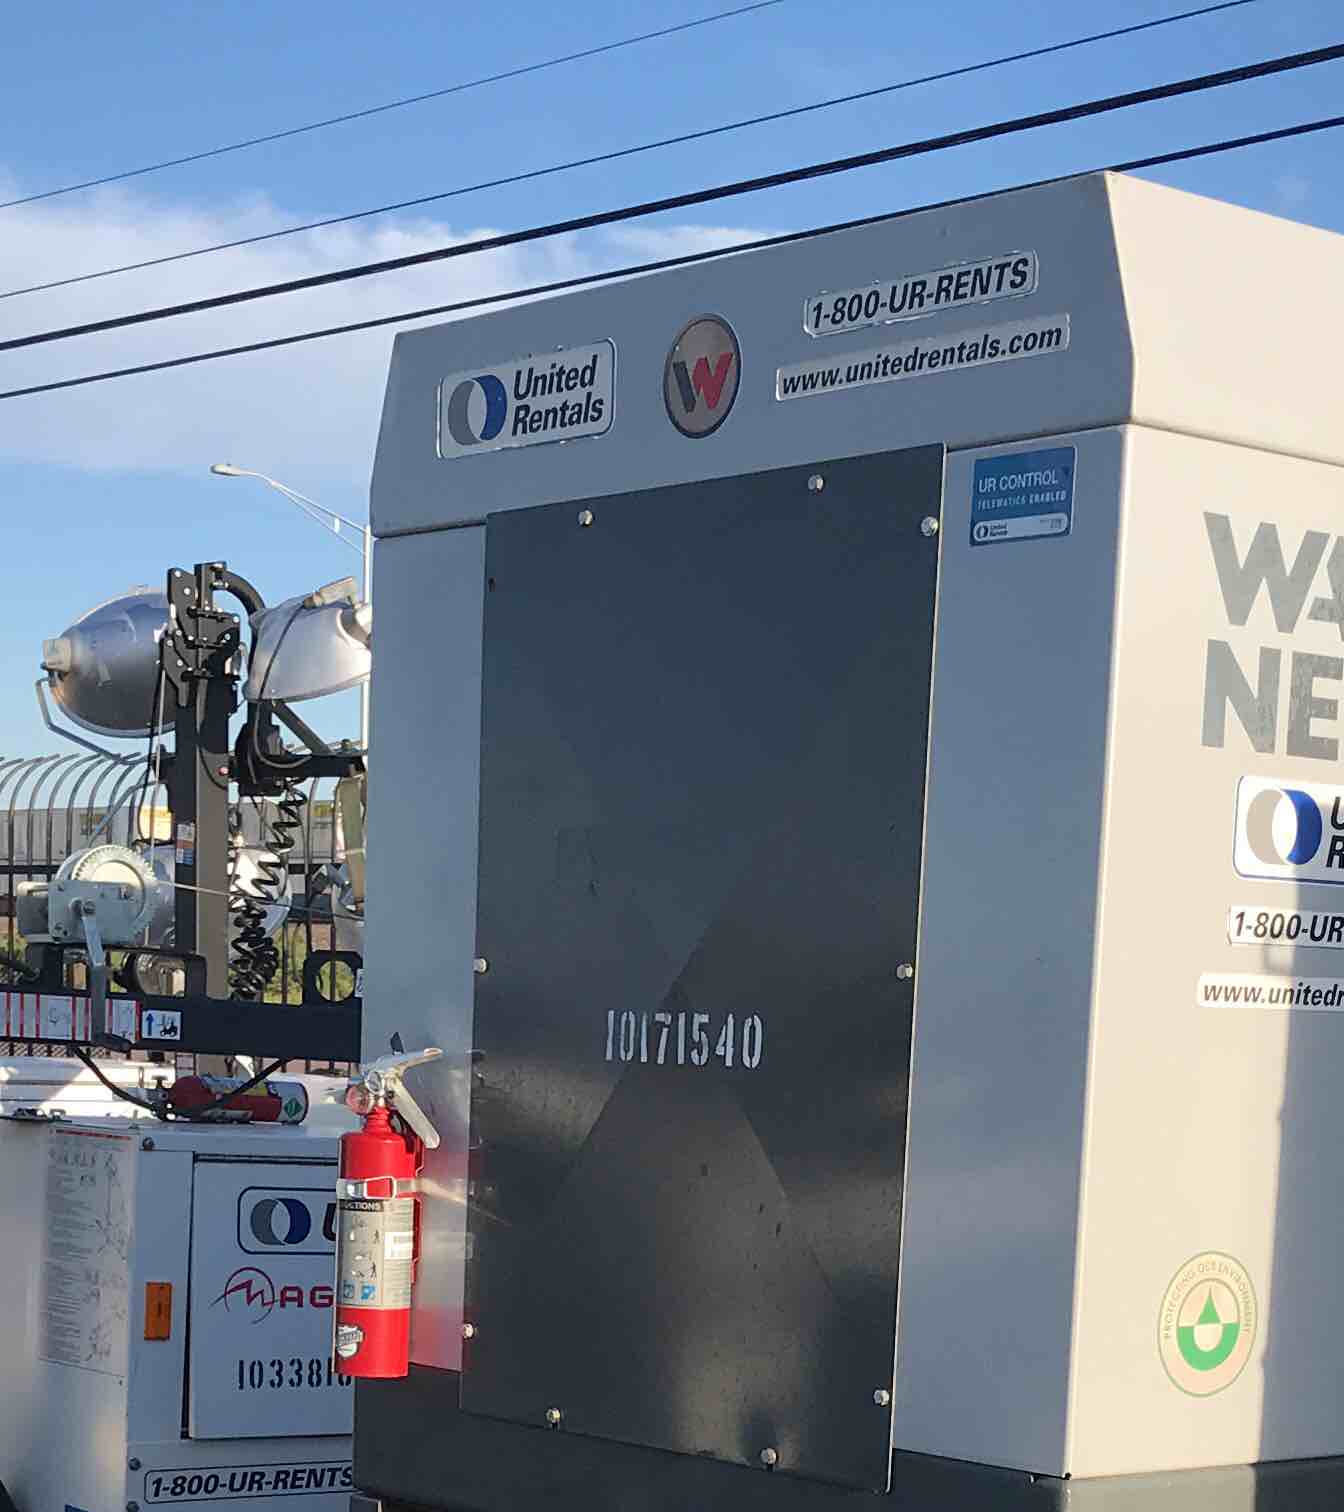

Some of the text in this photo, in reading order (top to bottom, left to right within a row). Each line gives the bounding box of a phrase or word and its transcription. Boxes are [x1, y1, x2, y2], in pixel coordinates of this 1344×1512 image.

[812, 256, 1030, 330] 1-800-UR-RENTS
[512, 355, 598, 401] United
[782, 324, 1063, 395] www.unitedrentals.com
[511, 388, 605, 438] Rentals
[978, 469, 1059, 493] UR CONTROL
[605, 1009, 764, 1069] 10171540
[151, 1465, 353, 1498] 1-800-UR-RENTS
